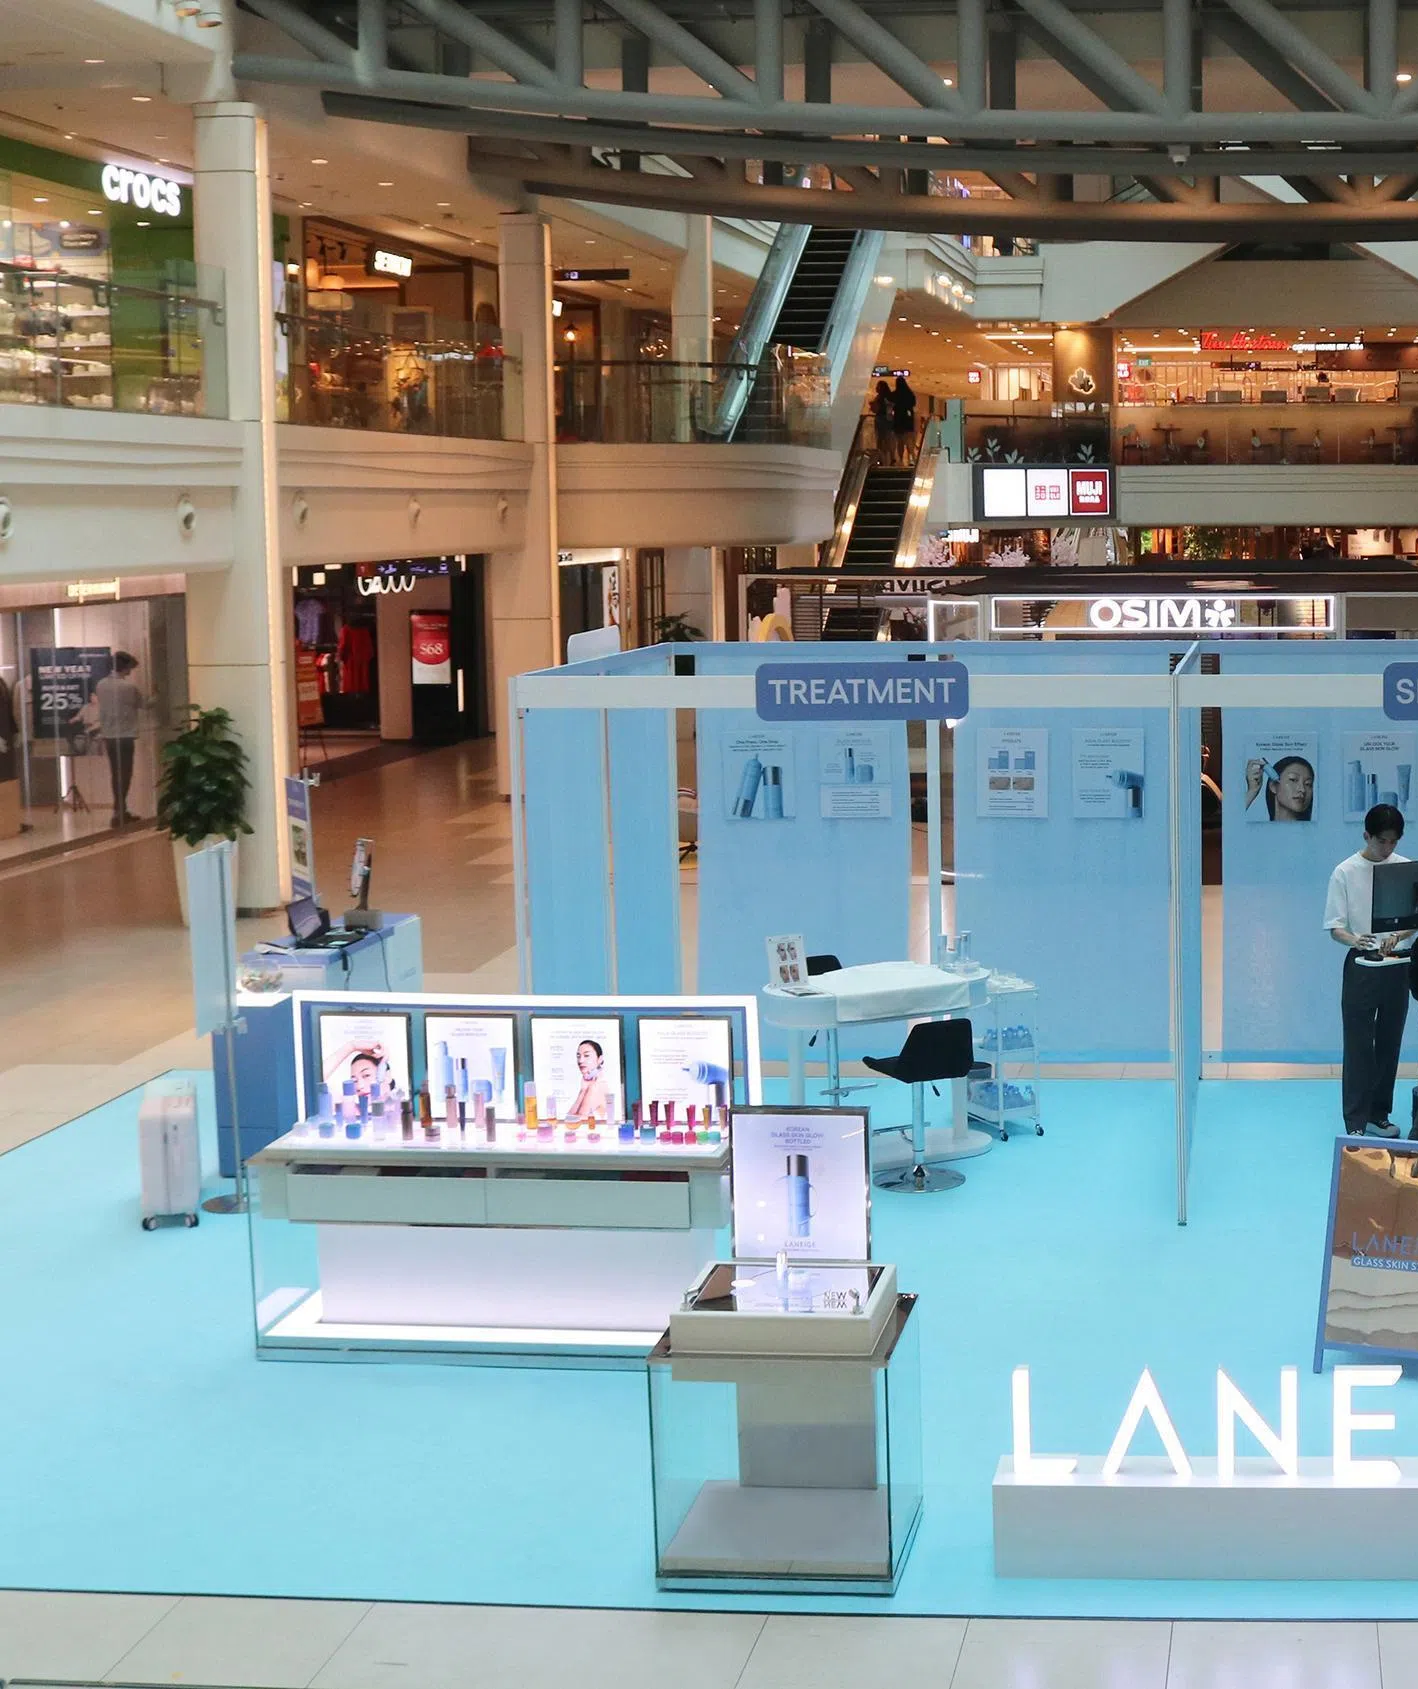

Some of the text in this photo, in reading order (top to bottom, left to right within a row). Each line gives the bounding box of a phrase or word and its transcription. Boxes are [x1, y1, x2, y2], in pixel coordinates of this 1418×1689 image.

[101, 164, 182, 217] crocs
[1230, 332, 1290, 350] Hortons
[1089, 599, 1201, 629] OSIM
[768, 677, 956, 705] TREATMENT
[1353, 1257, 1384, 1269] GLASS
[1385, 1259, 1410, 1271] SKIN
